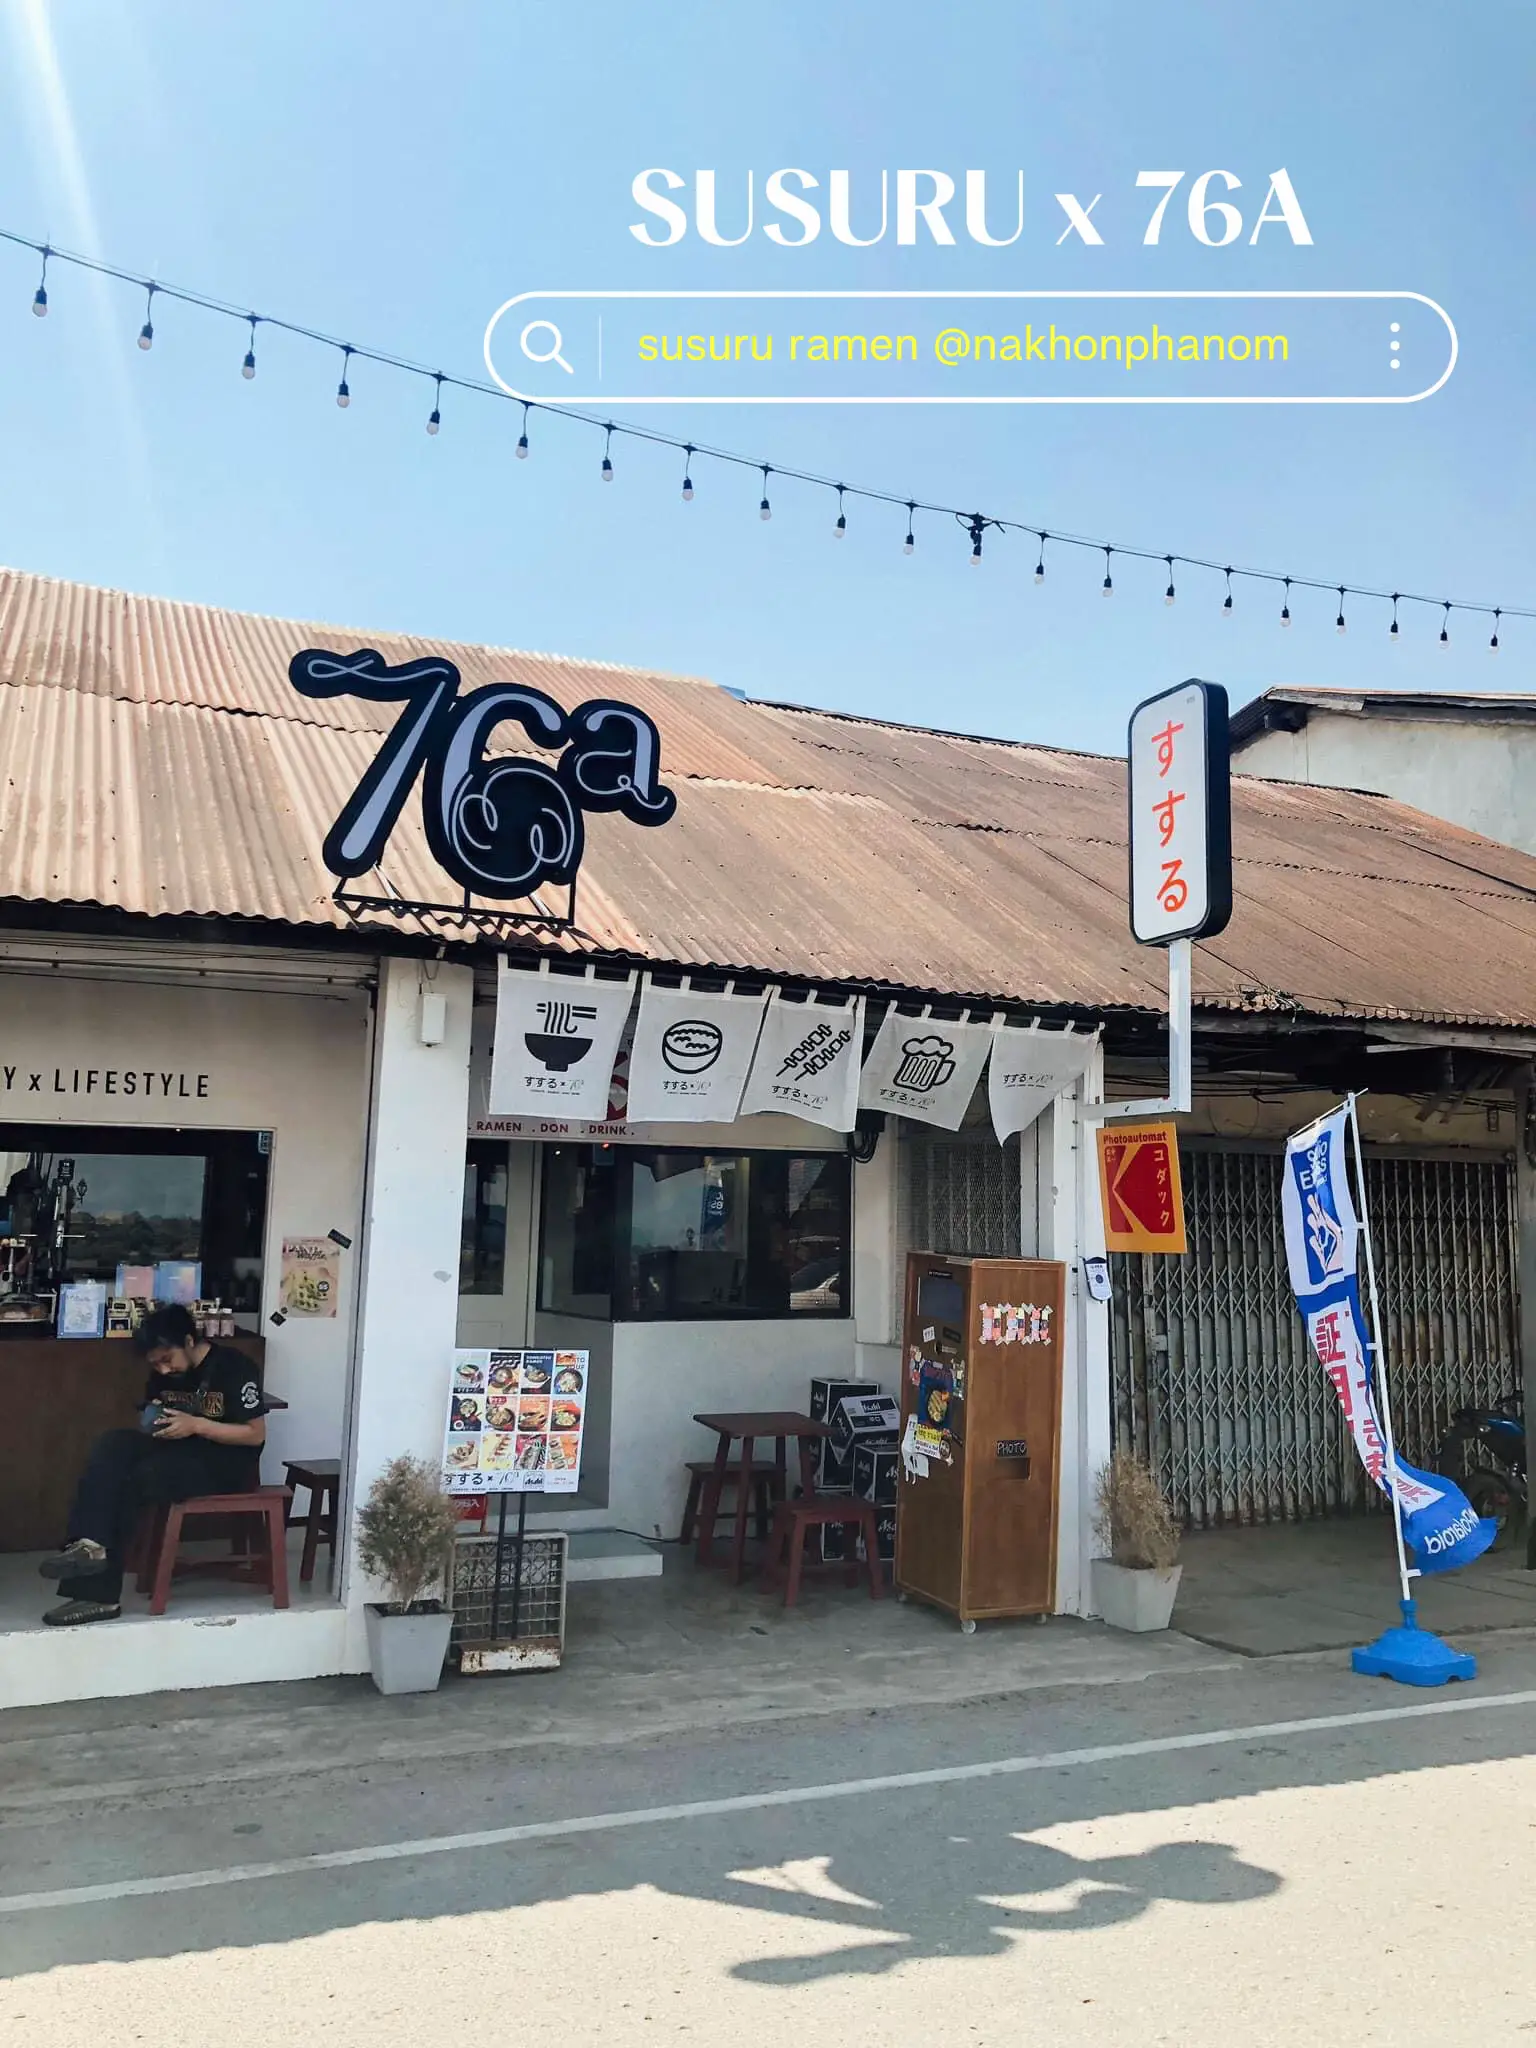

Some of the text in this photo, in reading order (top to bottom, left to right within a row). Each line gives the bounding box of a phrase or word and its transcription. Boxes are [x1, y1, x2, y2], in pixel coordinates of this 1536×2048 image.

[1151, 719, 1188, 913] すする
[54, 1068, 209, 1098] LIFESTYLE
[476, 1120, 626, 1135] RAMEN DON DRINK
[1103, 1131, 1168, 1144] Photoautomat
[1153, 1149, 1170, 1227] コダック
[997, 1441, 1026, 1455] PHOTO
[444, 1472, 483, 1485] すする
